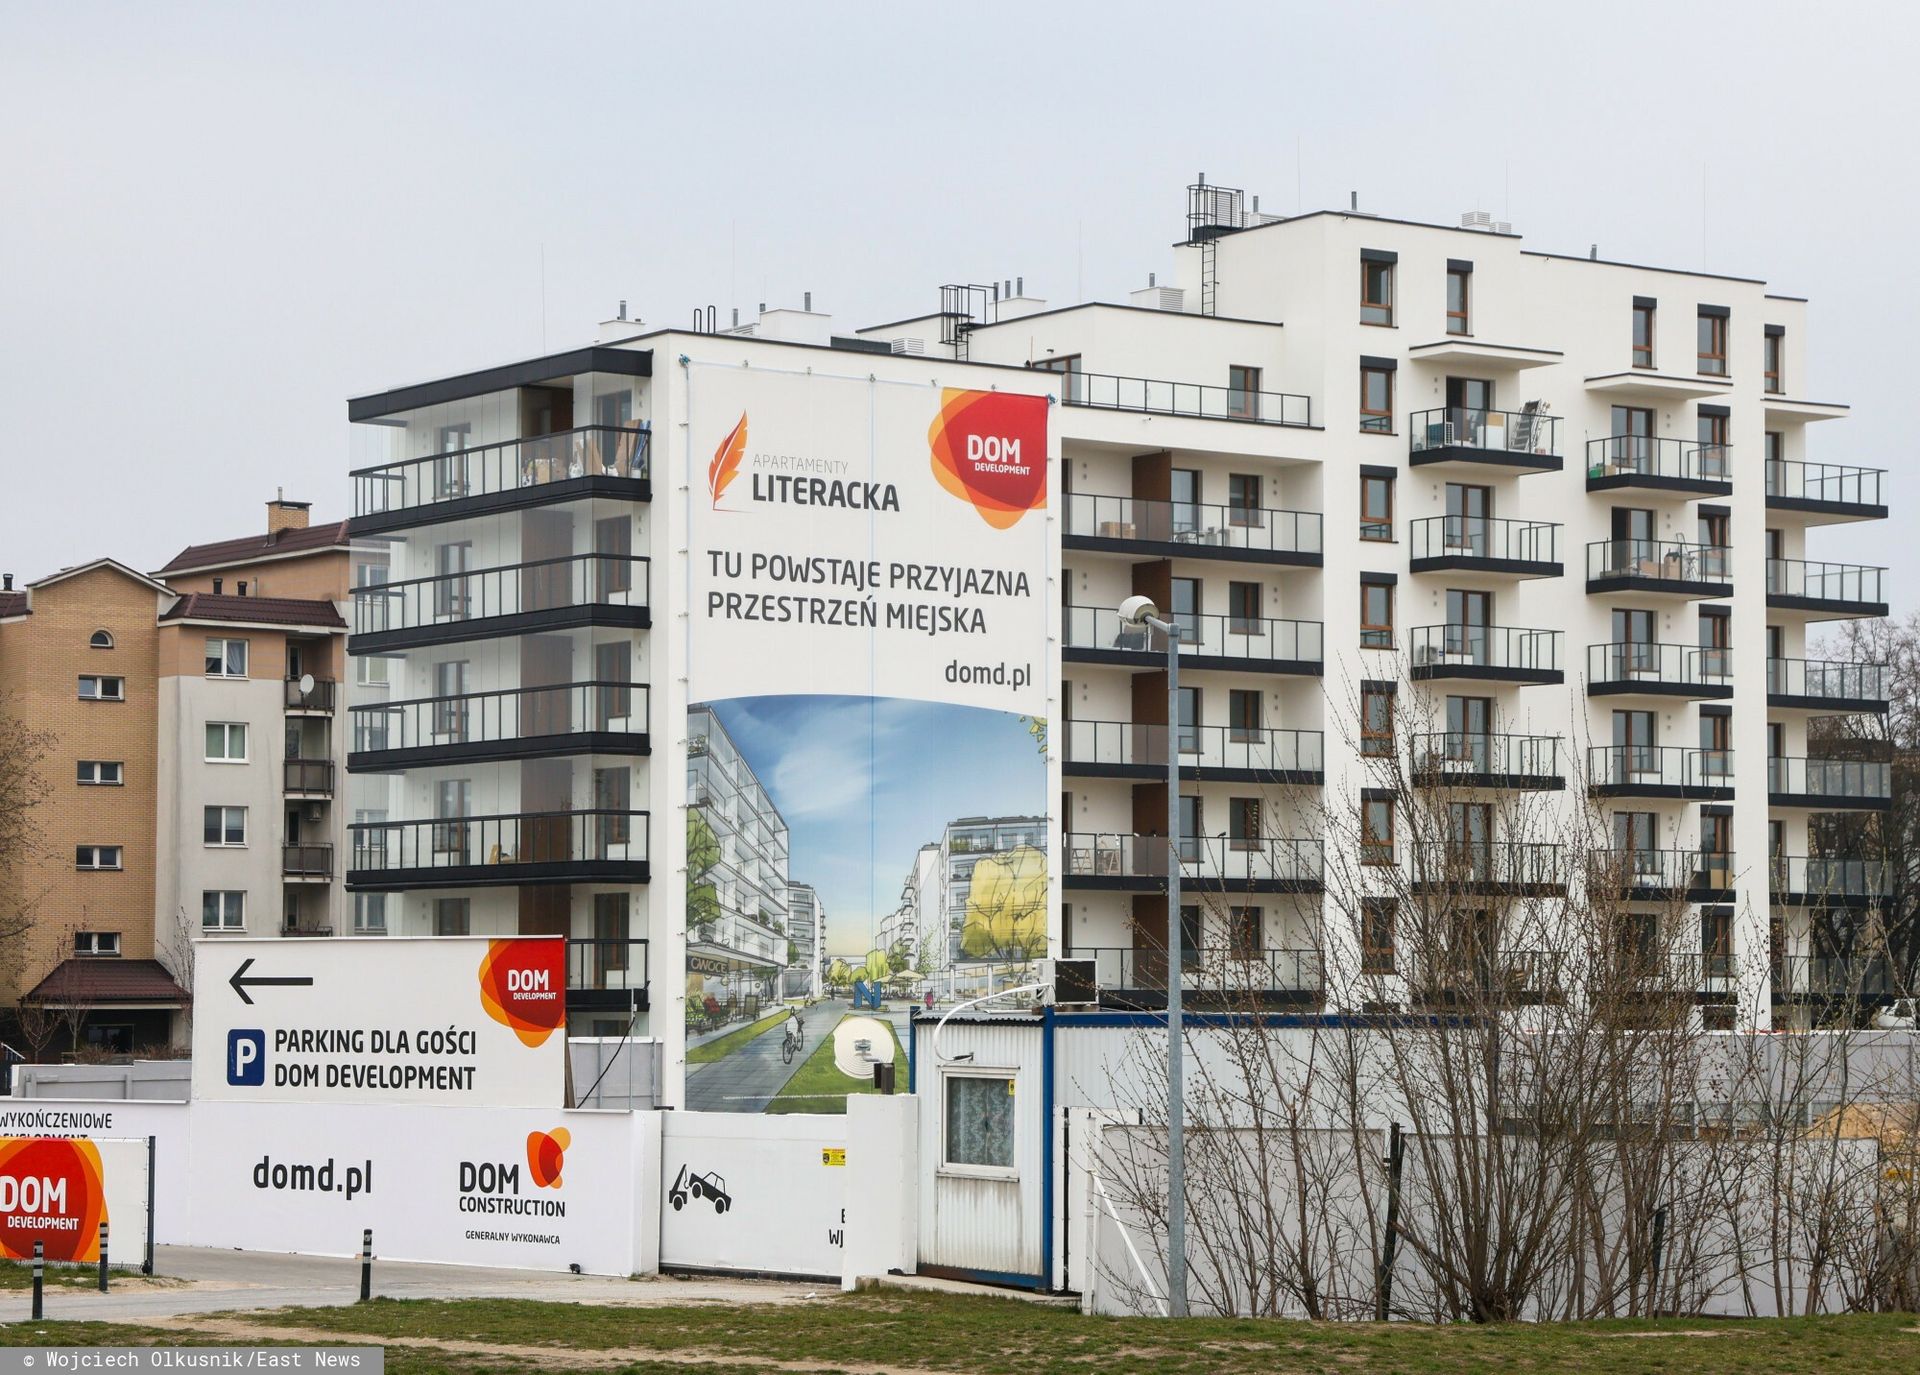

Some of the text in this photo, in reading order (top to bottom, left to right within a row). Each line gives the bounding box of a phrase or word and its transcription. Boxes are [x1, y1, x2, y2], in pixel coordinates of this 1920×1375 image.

[752, 453, 849, 475] APARTAMENTY
[967, 434, 1021, 464] DOM
[974, 461, 1031, 475] DEVELOPMENT
[752, 473, 900, 512] LITERACKA
[707, 550, 1031, 598] TU POWSTAJE PRZYJAZNA
[708, 591, 987, 636] PRZESTRZEŃ MIEJSKA
[945, 659, 1031, 691] domd.pl
[508, 969, 549, 991] DOM
[513, 992, 557, 1000] DEVELOPMENT
[275, 1025, 476, 1055] PARKING DLA GOŚCI
[236, 1038, 257, 1077] P
[274, 1063, 476, 1090] DOM DEVELOPMENT
[0, 1109, 113, 1129] WYKOŃCZENIOWE
[253, 1156, 372, 1201] domd.pl
[459, 1161, 519, 1195] DOM
[0, 1175, 67, 1214] DOM
[459, 1196, 566, 1218] CONSTRUCTION
[7, 1215, 79, 1231] DEVELOPMENT
[465, 1230, 561, 1245] GENERALNY WYKONAWCA
